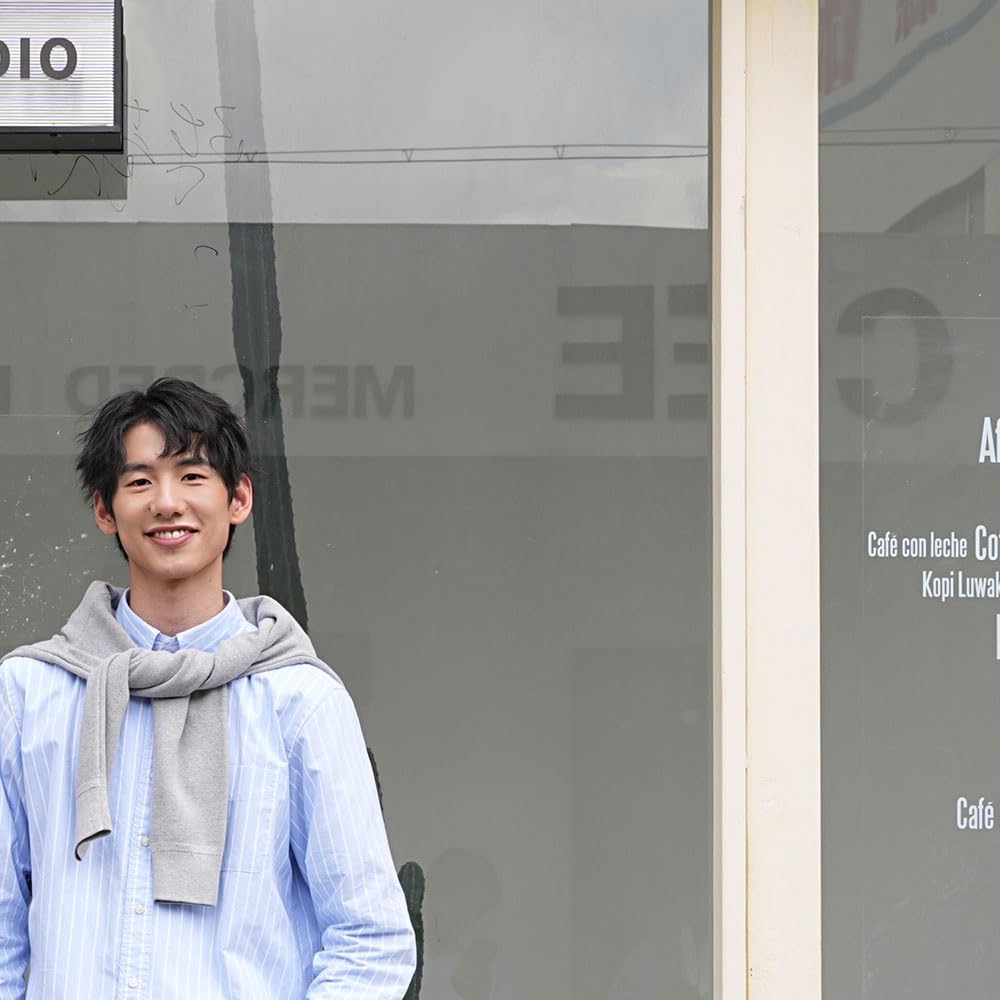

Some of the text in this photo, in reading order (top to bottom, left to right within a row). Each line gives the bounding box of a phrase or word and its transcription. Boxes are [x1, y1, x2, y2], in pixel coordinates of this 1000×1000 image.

[868, 525, 1000, 561] Café con leche Co
[922, 571, 954, 602] Kopi
[957, 797, 994, 829] Café
